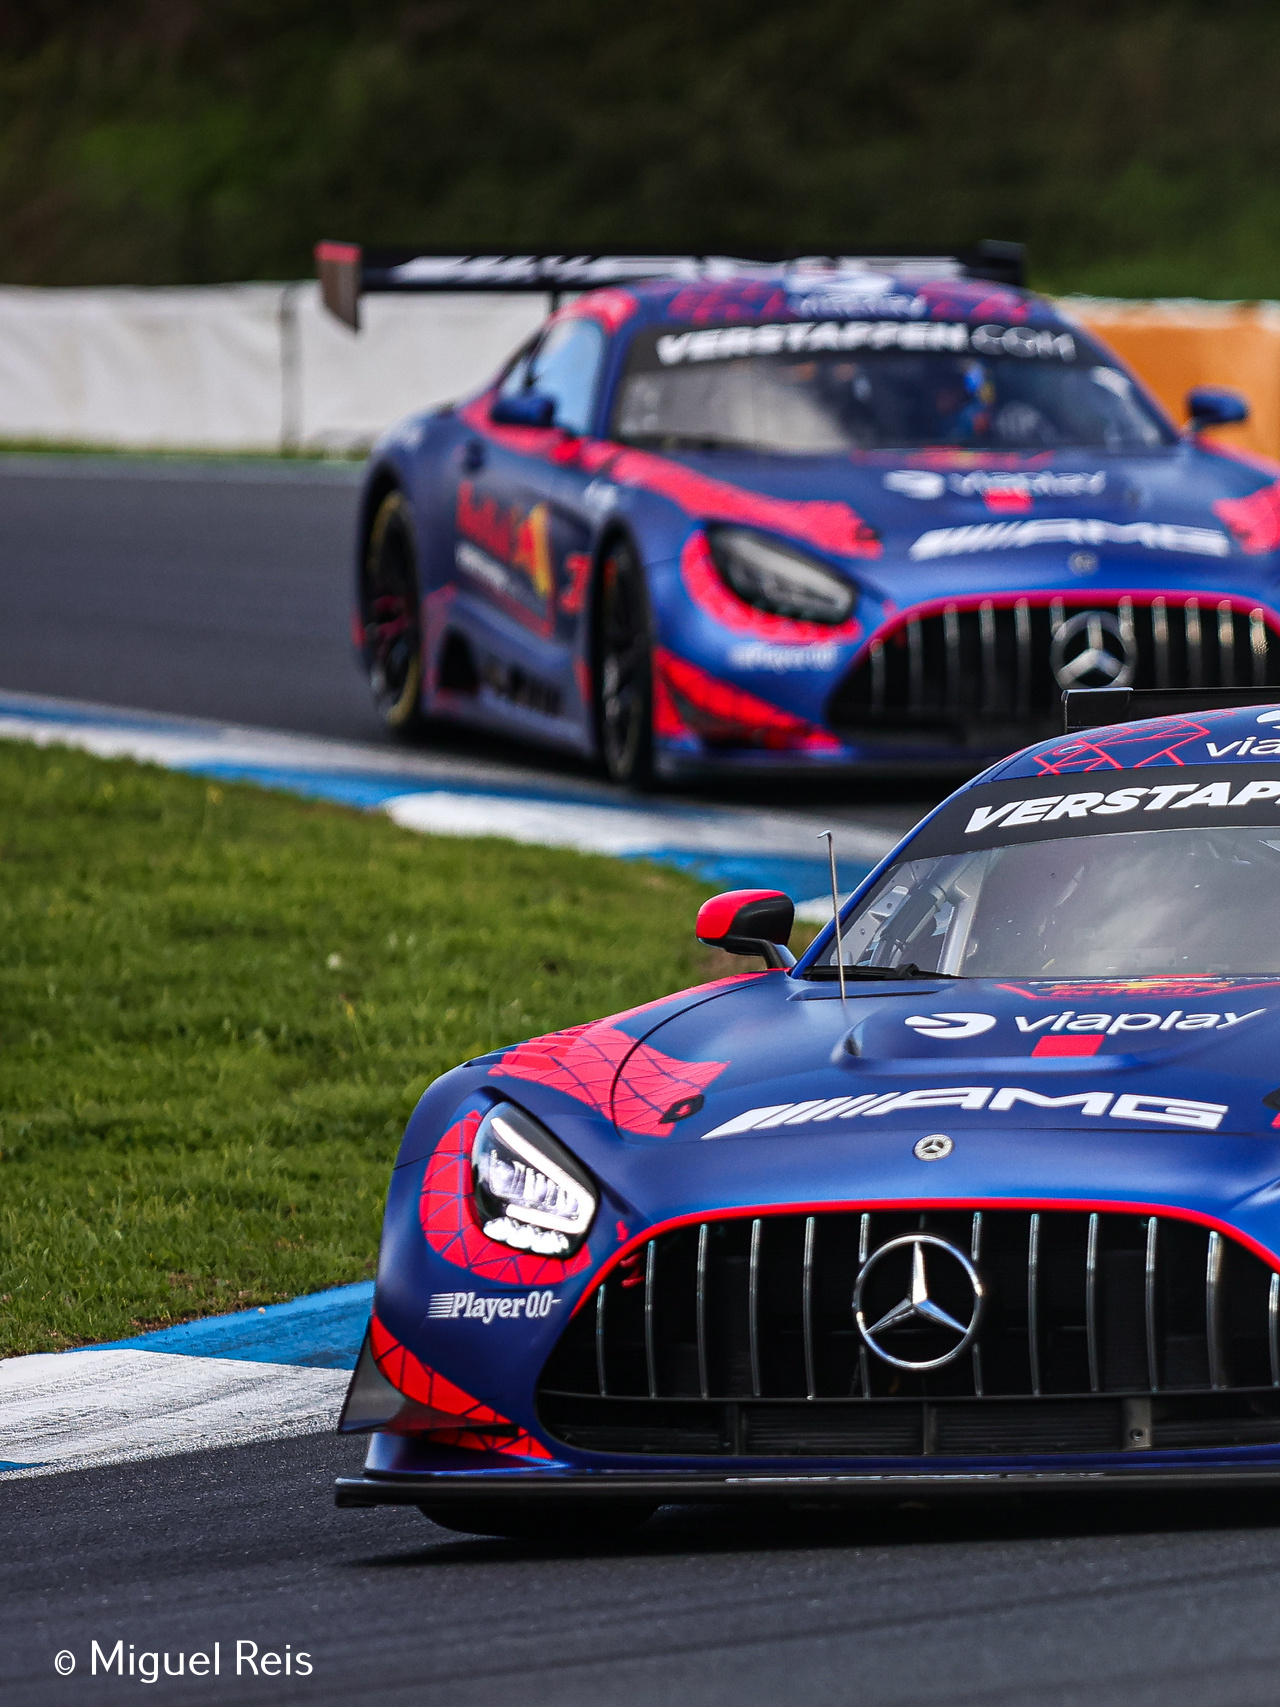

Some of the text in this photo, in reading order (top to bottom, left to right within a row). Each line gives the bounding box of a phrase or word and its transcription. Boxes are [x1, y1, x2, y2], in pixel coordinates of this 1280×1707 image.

[1014, 1007, 1267, 1035] viaplay
[862, 1086, 1230, 1130] AMG
[448, 1291, 526, 1325] Player
